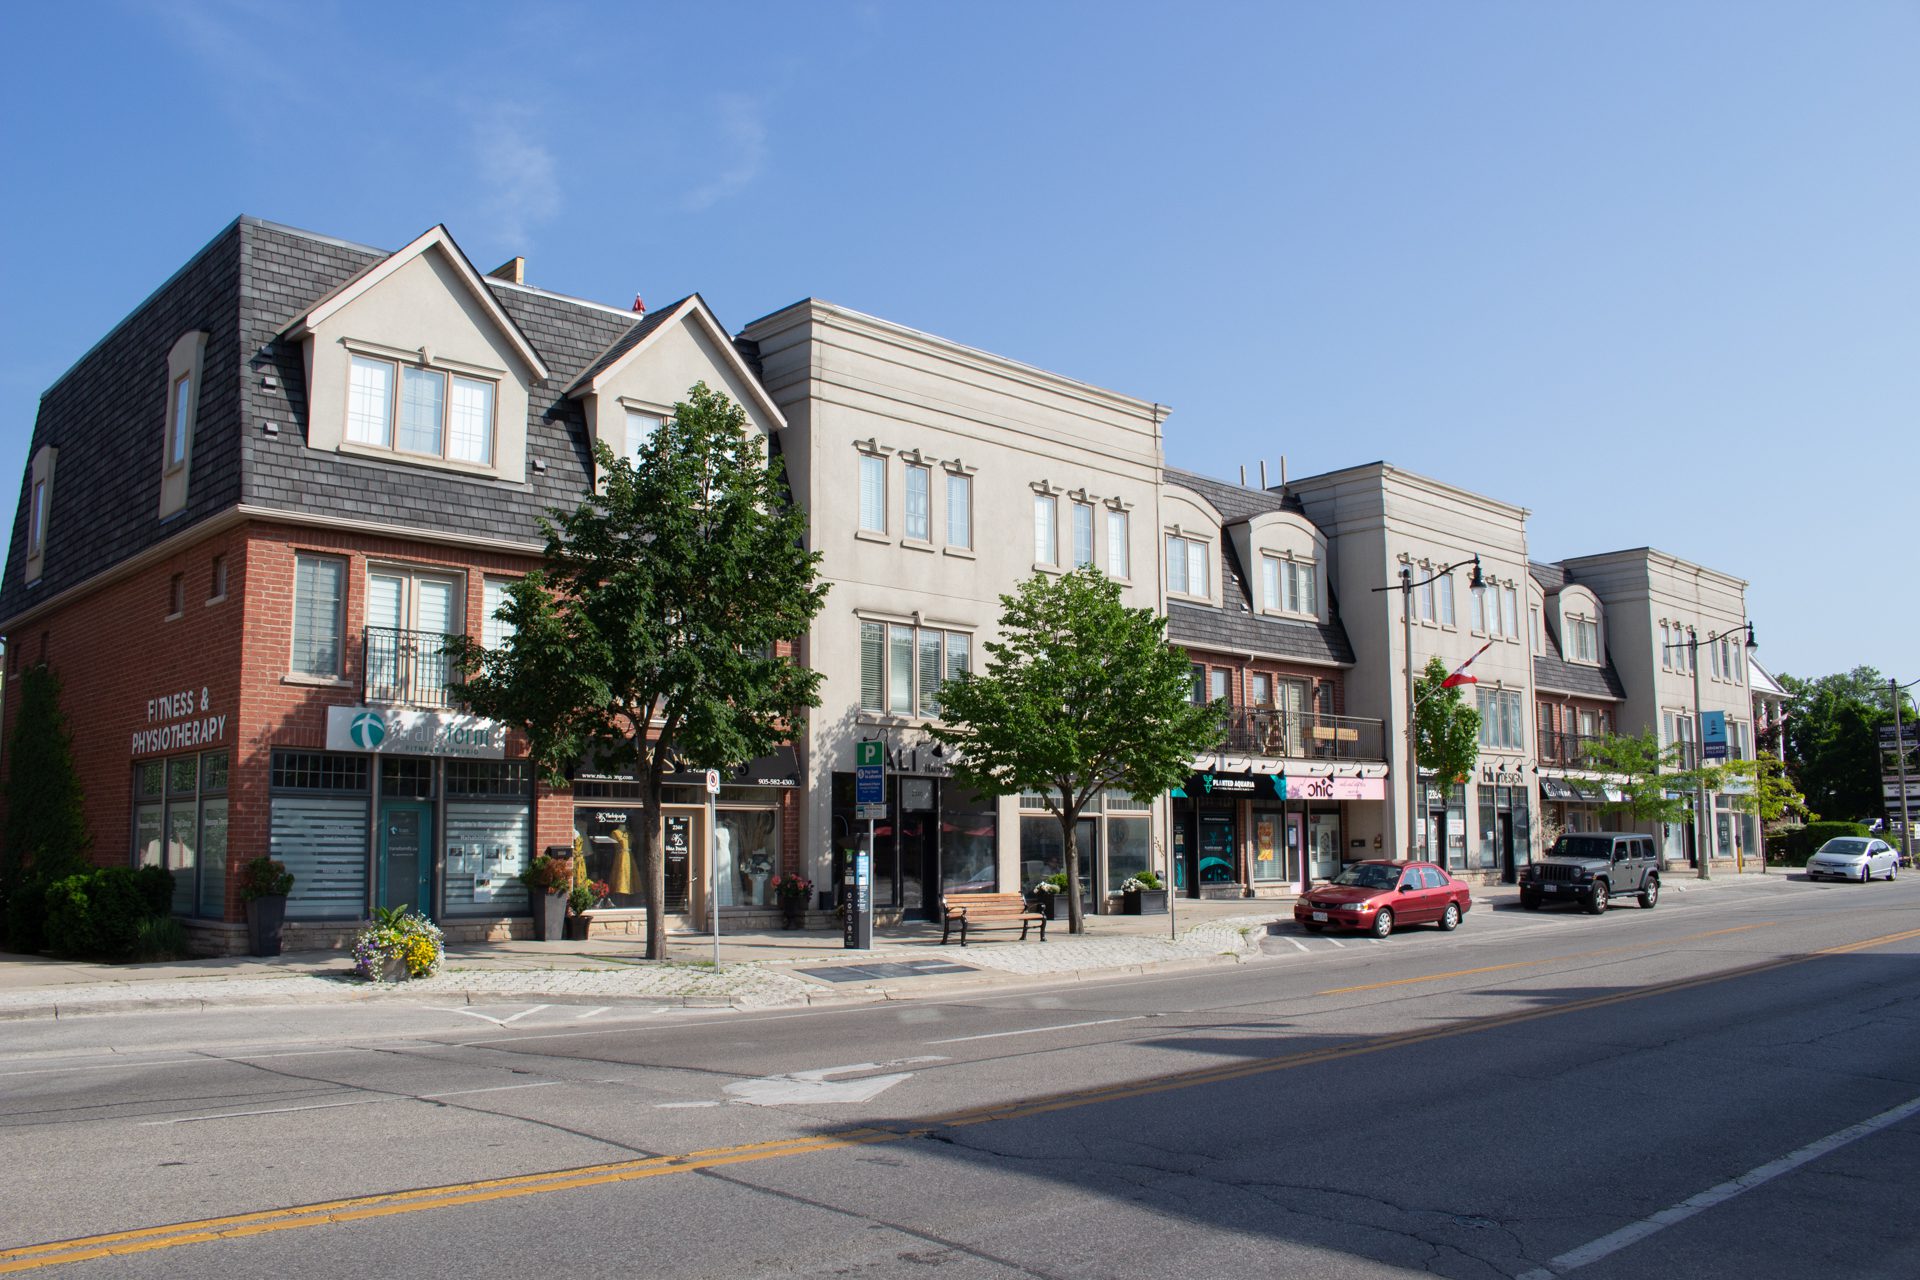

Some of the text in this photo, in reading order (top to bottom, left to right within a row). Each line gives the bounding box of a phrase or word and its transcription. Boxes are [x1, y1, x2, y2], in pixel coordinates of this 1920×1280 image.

[148, 686, 209, 722] FITNESS &
[131, 714, 227, 755] PHYSIOTHERAPY
[865, 745, 876, 763] P
[1212, 779, 1256, 788] PLANTED AQUARIA
[1501, 773, 1523, 784] DESIGN
